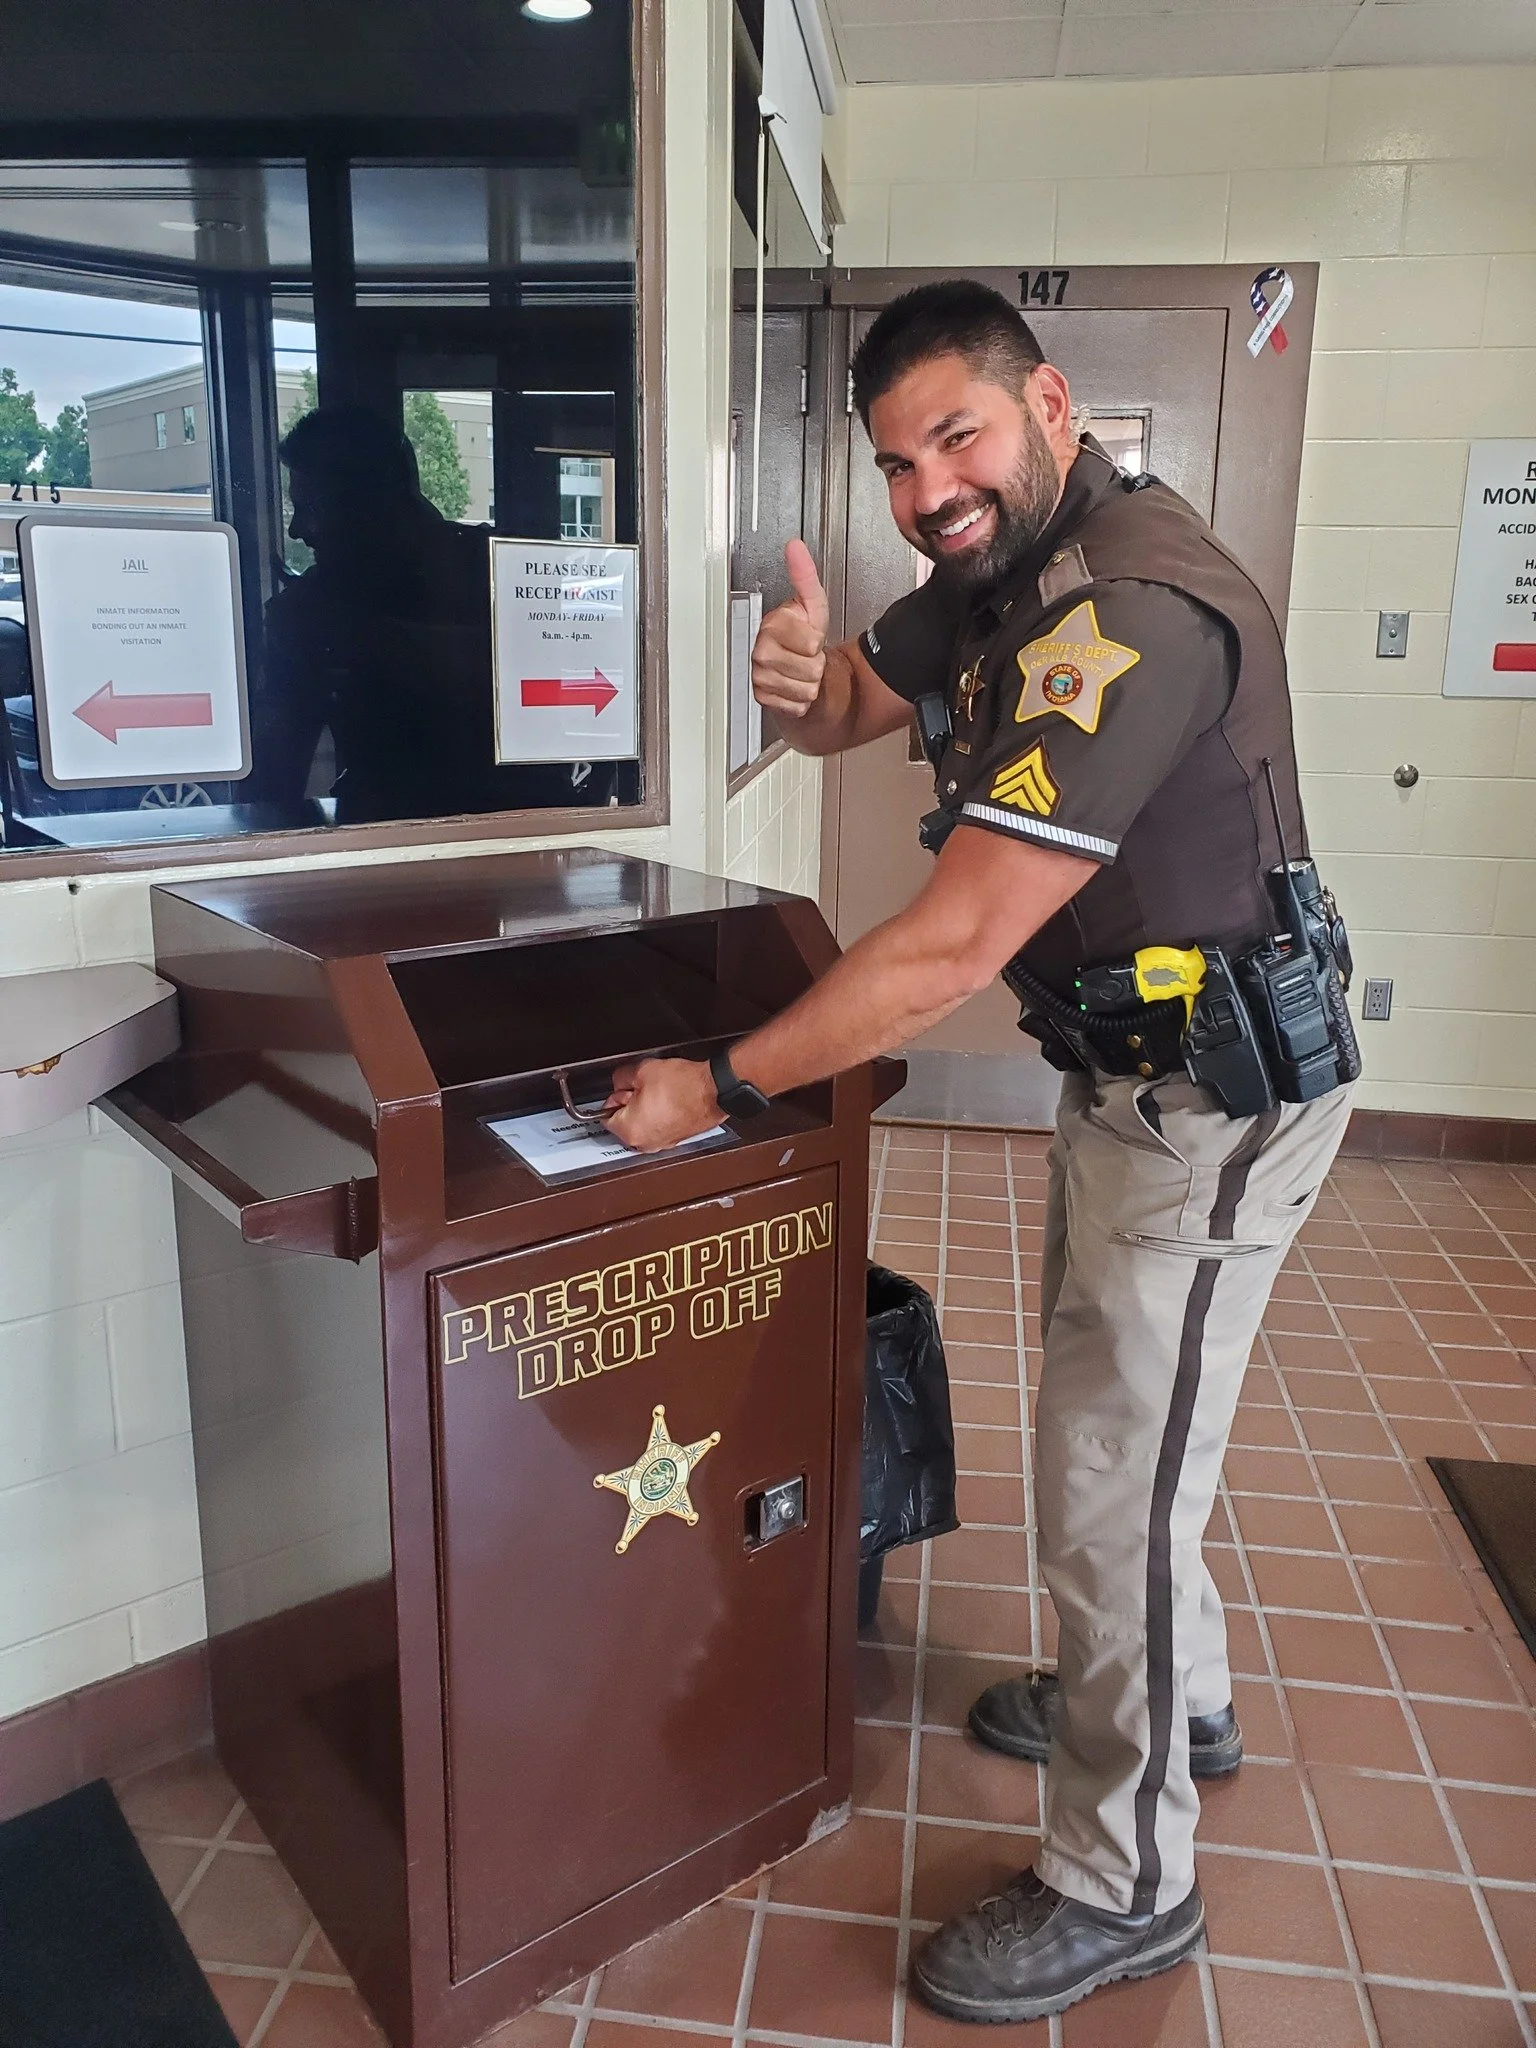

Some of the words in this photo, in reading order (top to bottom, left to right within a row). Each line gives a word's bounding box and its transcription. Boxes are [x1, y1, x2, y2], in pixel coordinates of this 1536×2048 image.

[1017, 270, 1070, 306] 147
[10, 480, 61, 504] 215
[122, 559, 149, 571] JAIL
[525, 562, 579, 576] PLEASE
[581, 564, 607, 577] SEE
[515, 586, 617, 600] RECEPTIONIST
[1505, 593, 1529, 605] SEX
[96, 607, 126, 615] INMATE
[127, 607, 181, 615] INFORMATION
[572, 613, 606, 622] FRIDAY
[92, 622, 127, 630] BONDING
[128, 622, 145, 630] OUT
[541, 631, 564, 640] 8a.m.
[570, 632, 593, 642] 4p.m.
[1029, 643, 1081, 656] SHERIFF'S
[1049, 665, 1073, 677] STATE
[1072, 669, 1081, 681] OF
[1071, 655, 1108, 679] COUNTY
[1045, 690, 1076, 703] INDIANA
[551, 1121, 589, 1133] Needles
[600, 1146, 631, 1156] Thank
[444, 1202, 833, 1365] PRESCRIPTION
[518, 1303, 675, 1400] DROP
[690, 1268, 783, 1341] OFF
[630, 1444, 687, 1481] SHERIFF
[633, 1481, 685, 1513] INDIANA
